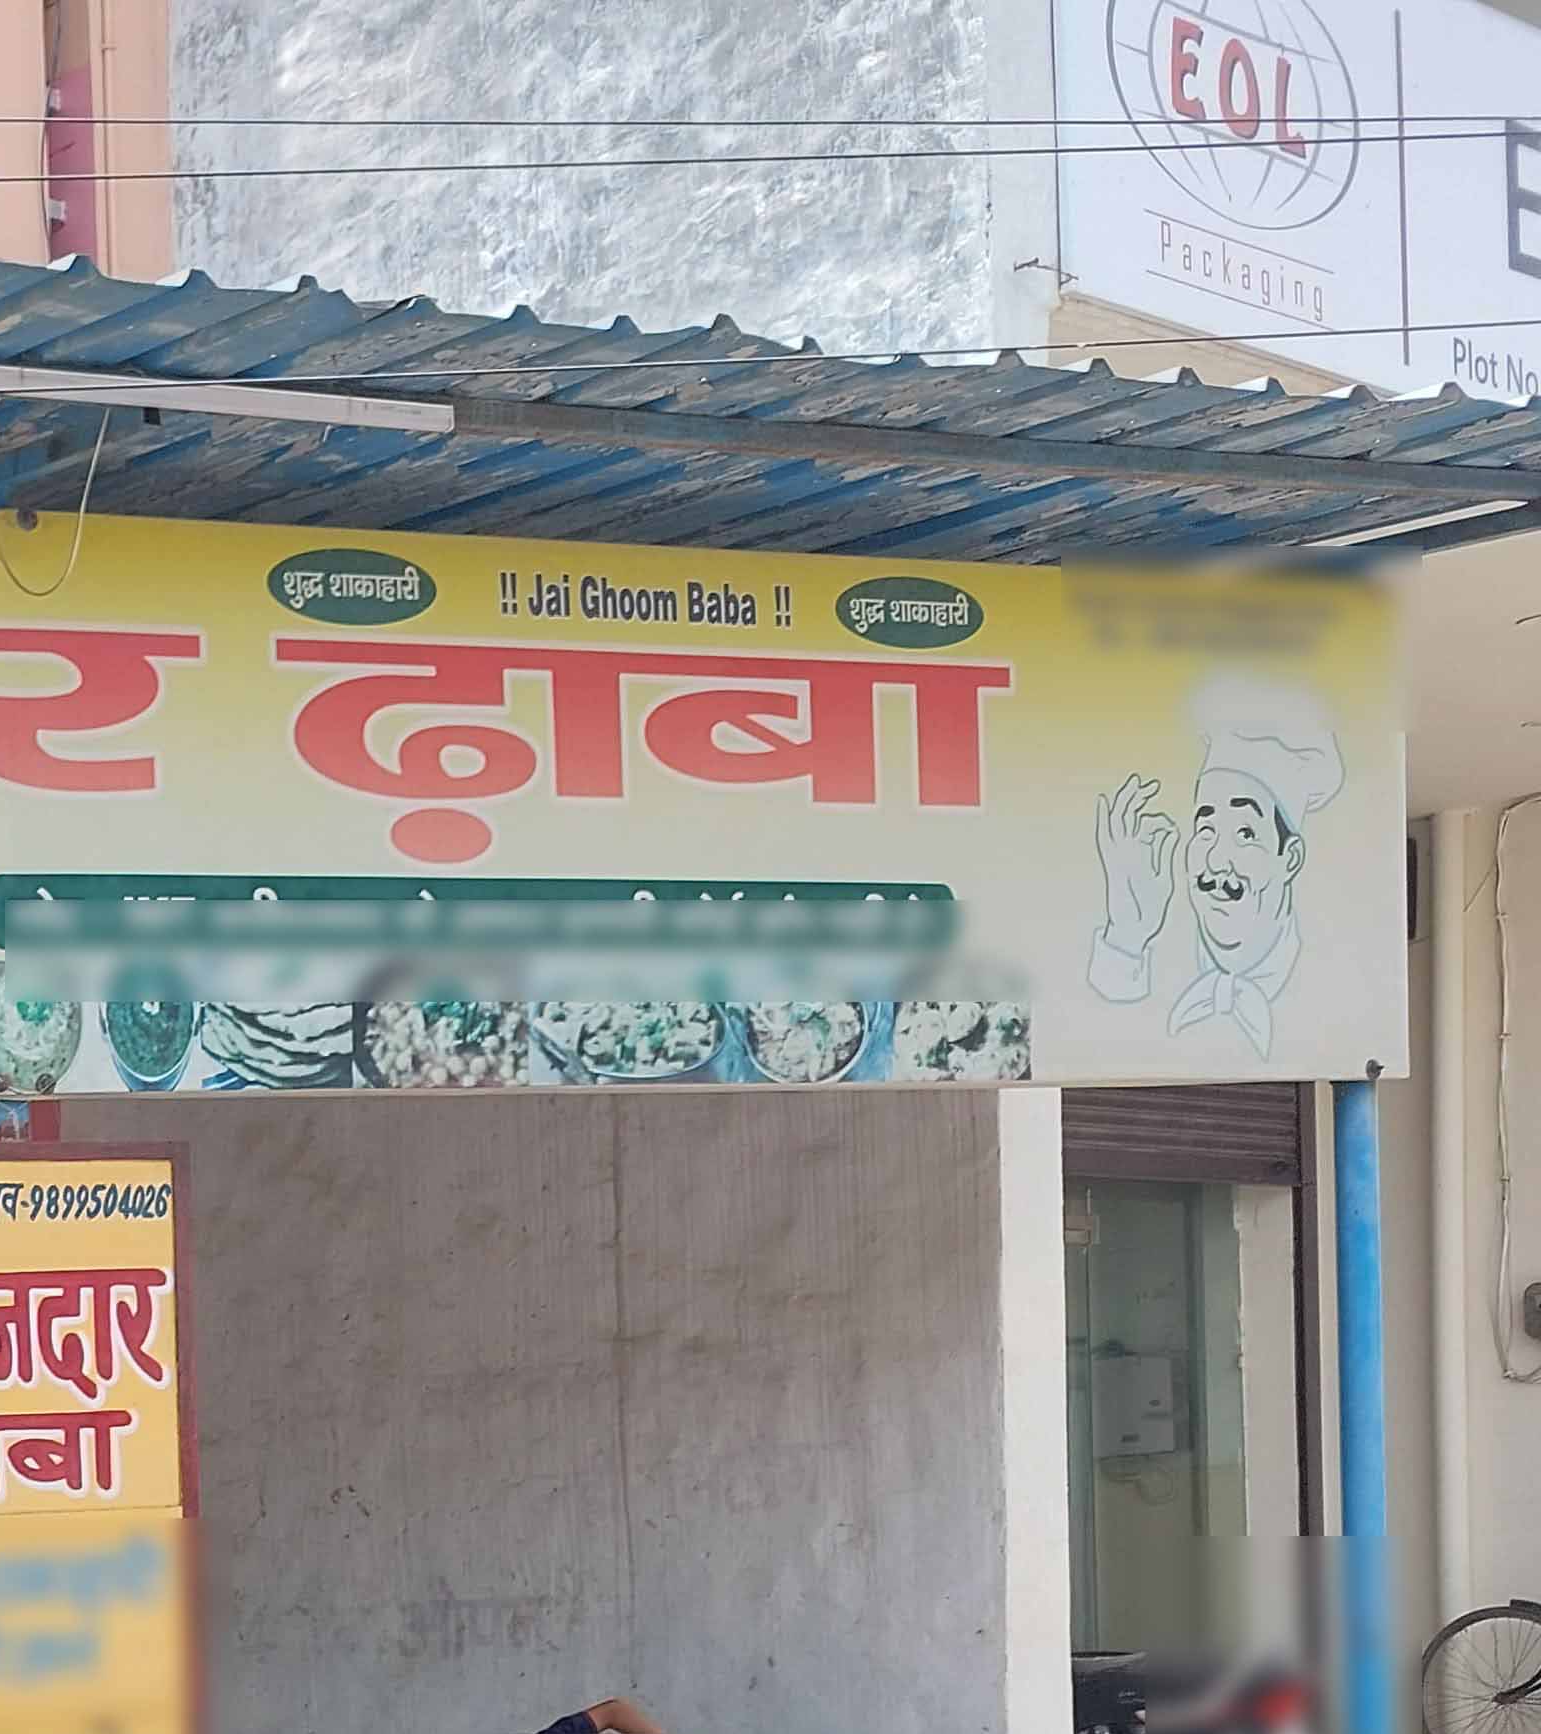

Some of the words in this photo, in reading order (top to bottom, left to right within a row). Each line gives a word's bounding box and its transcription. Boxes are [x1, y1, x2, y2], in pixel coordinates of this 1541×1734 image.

[1171, 15, 1307, 159] EOL
[1159, 220, 1324, 322] Packaging
[1453, 336, 1498, 389] Plot
[329, 565, 421, 603] शाकाहारी
[527, 573, 571, 617] Jai
[580, 575, 678, 622] Ghoom
[686, 581, 757, 626] Baba
[890, 592, 970, 627] शाकाहारी
